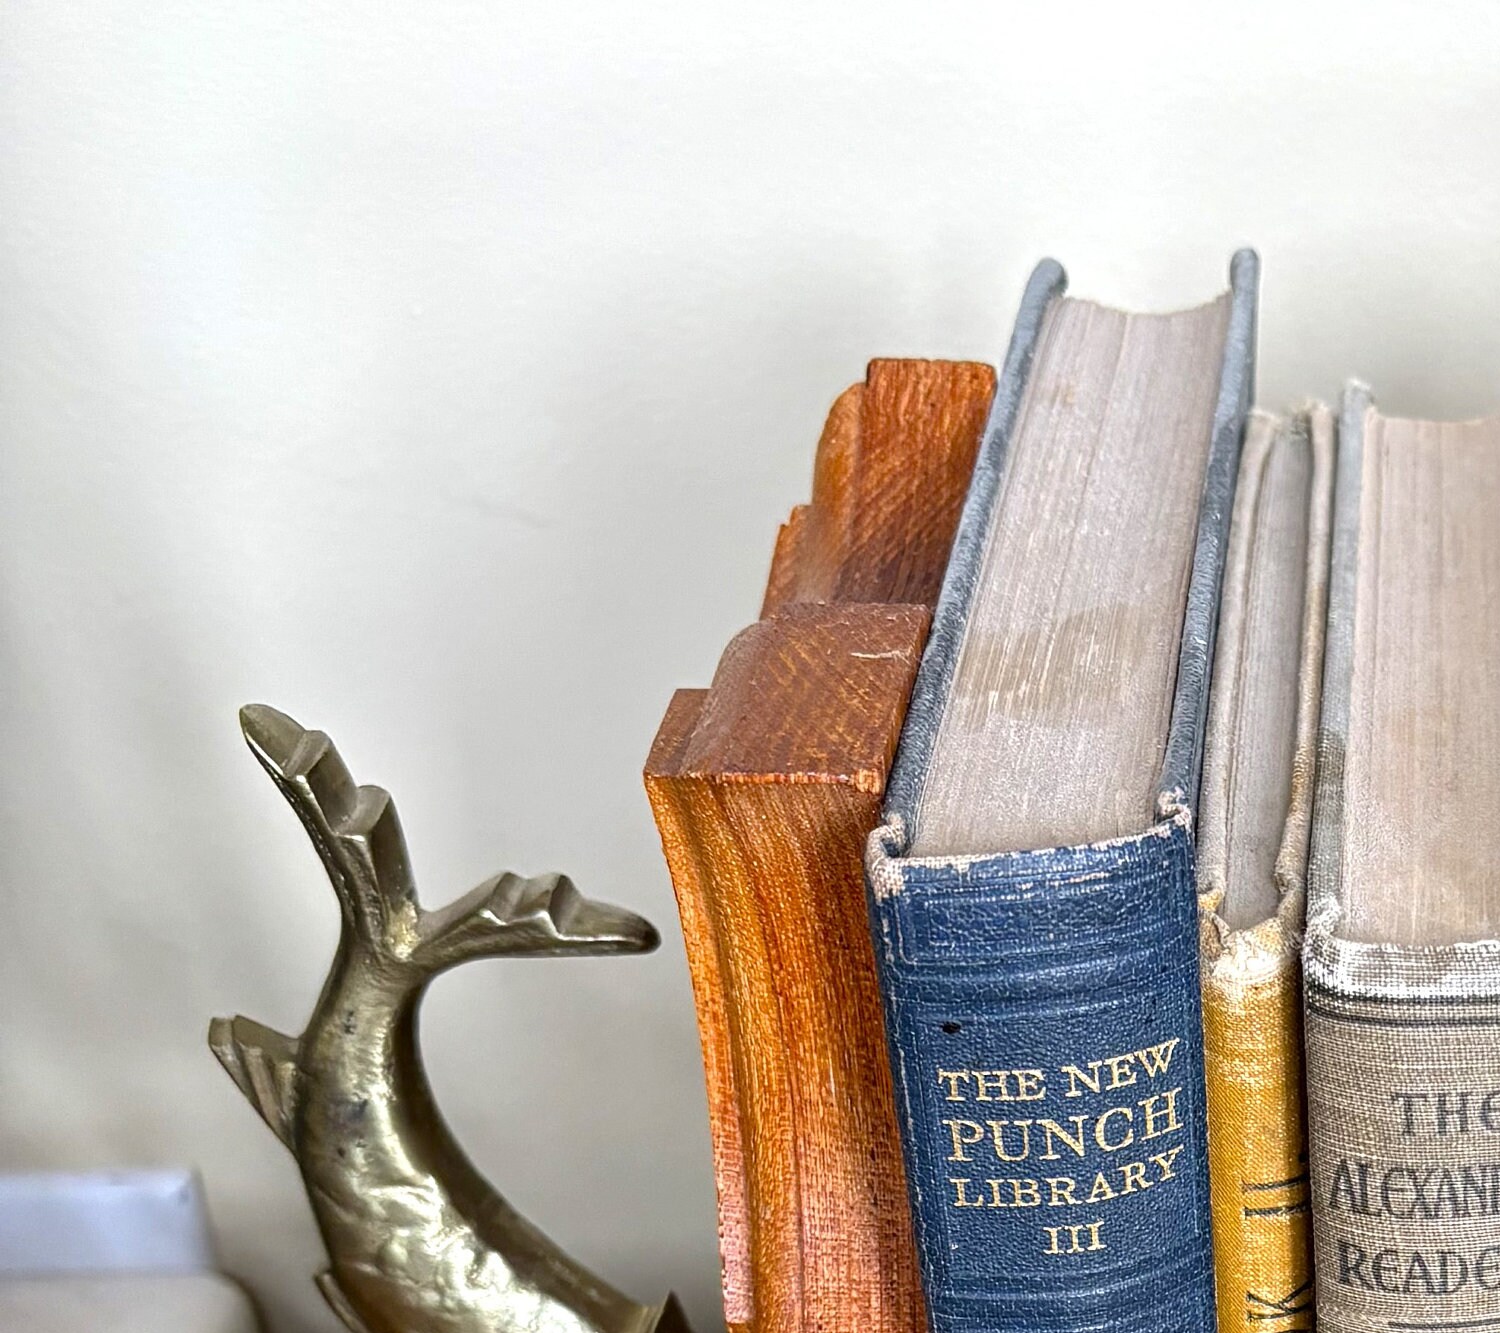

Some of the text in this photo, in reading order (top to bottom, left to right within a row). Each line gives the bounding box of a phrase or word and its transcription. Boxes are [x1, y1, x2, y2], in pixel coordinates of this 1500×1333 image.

[938, 1037, 1181, 1102] THE NEW
[943, 1086, 1184, 1162] PUNCH
[949, 1145, 1185, 1208] LIBRARY
[1042, 1218, 1108, 1255] III
